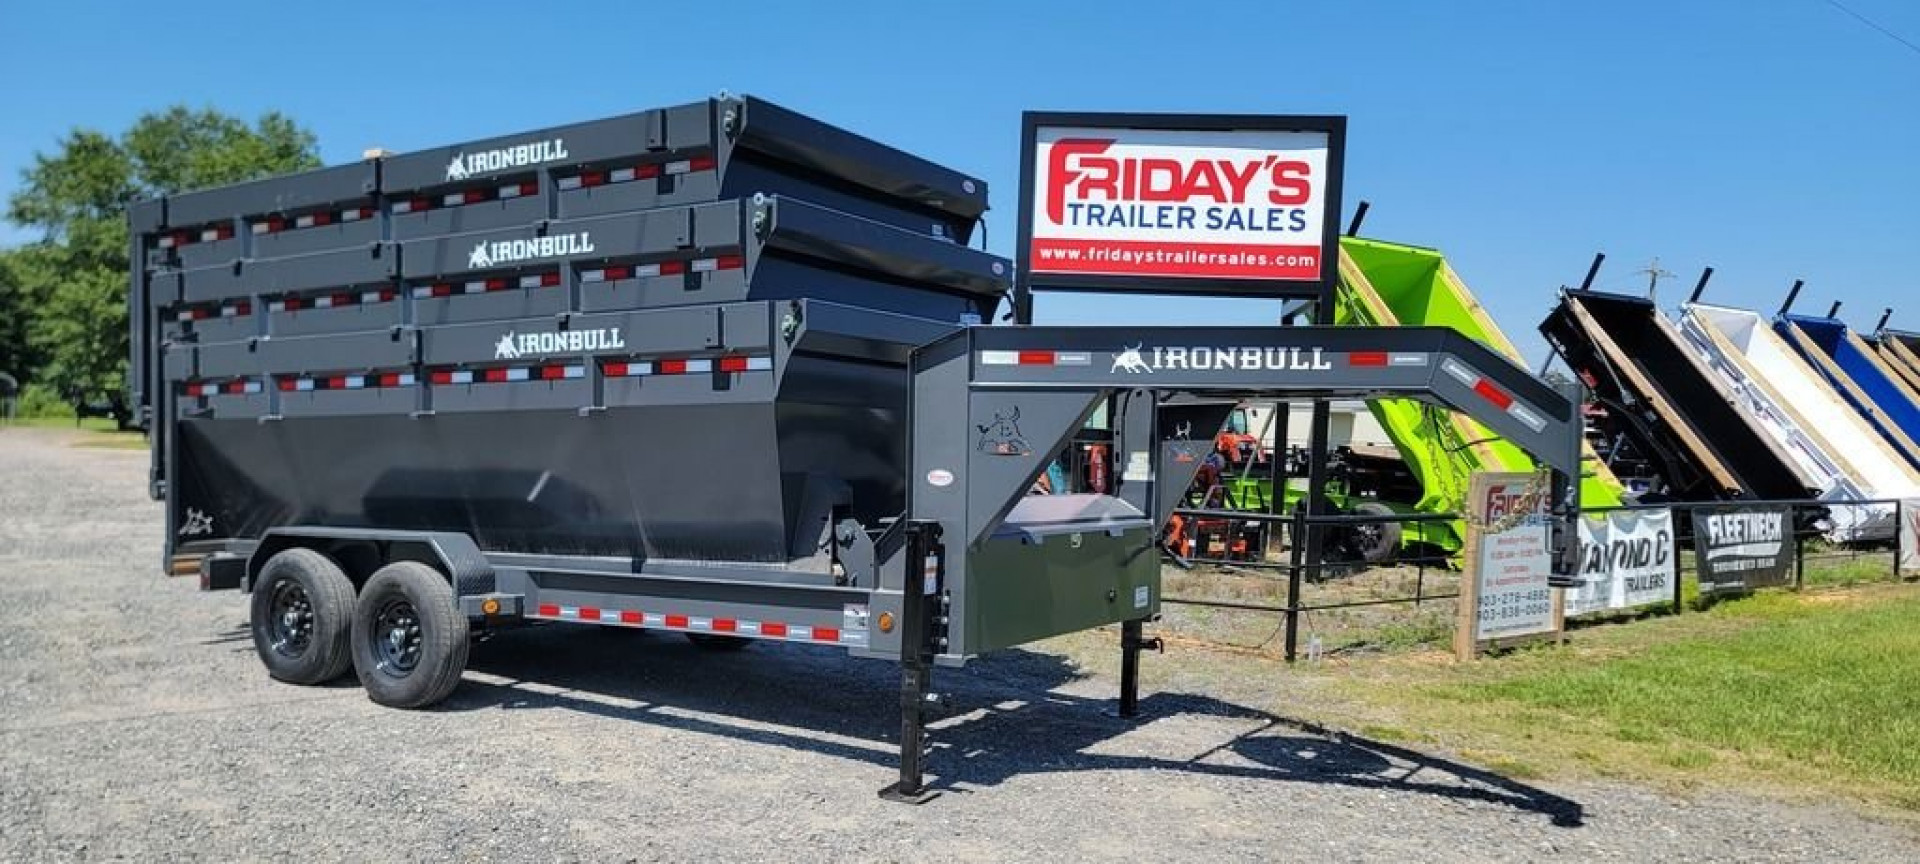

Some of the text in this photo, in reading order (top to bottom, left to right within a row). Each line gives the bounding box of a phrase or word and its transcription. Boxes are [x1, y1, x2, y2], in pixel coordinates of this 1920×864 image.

[467, 139, 568, 173] IRONBULL
[1046, 138, 1312, 226] FRIDAY'S
[1067, 203, 1307, 232] TRAILER SALES
[491, 232, 595, 263] IRONBULL
[1039, 246, 1316, 267] www.fridaystrailersales.com
[517, 327, 625, 355] IRONBULL
[1151, 345, 1333, 371] IRONBULL
[1708, 512, 1782, 546] FLEETNECK
[1655, 529, 1670, 567] C
